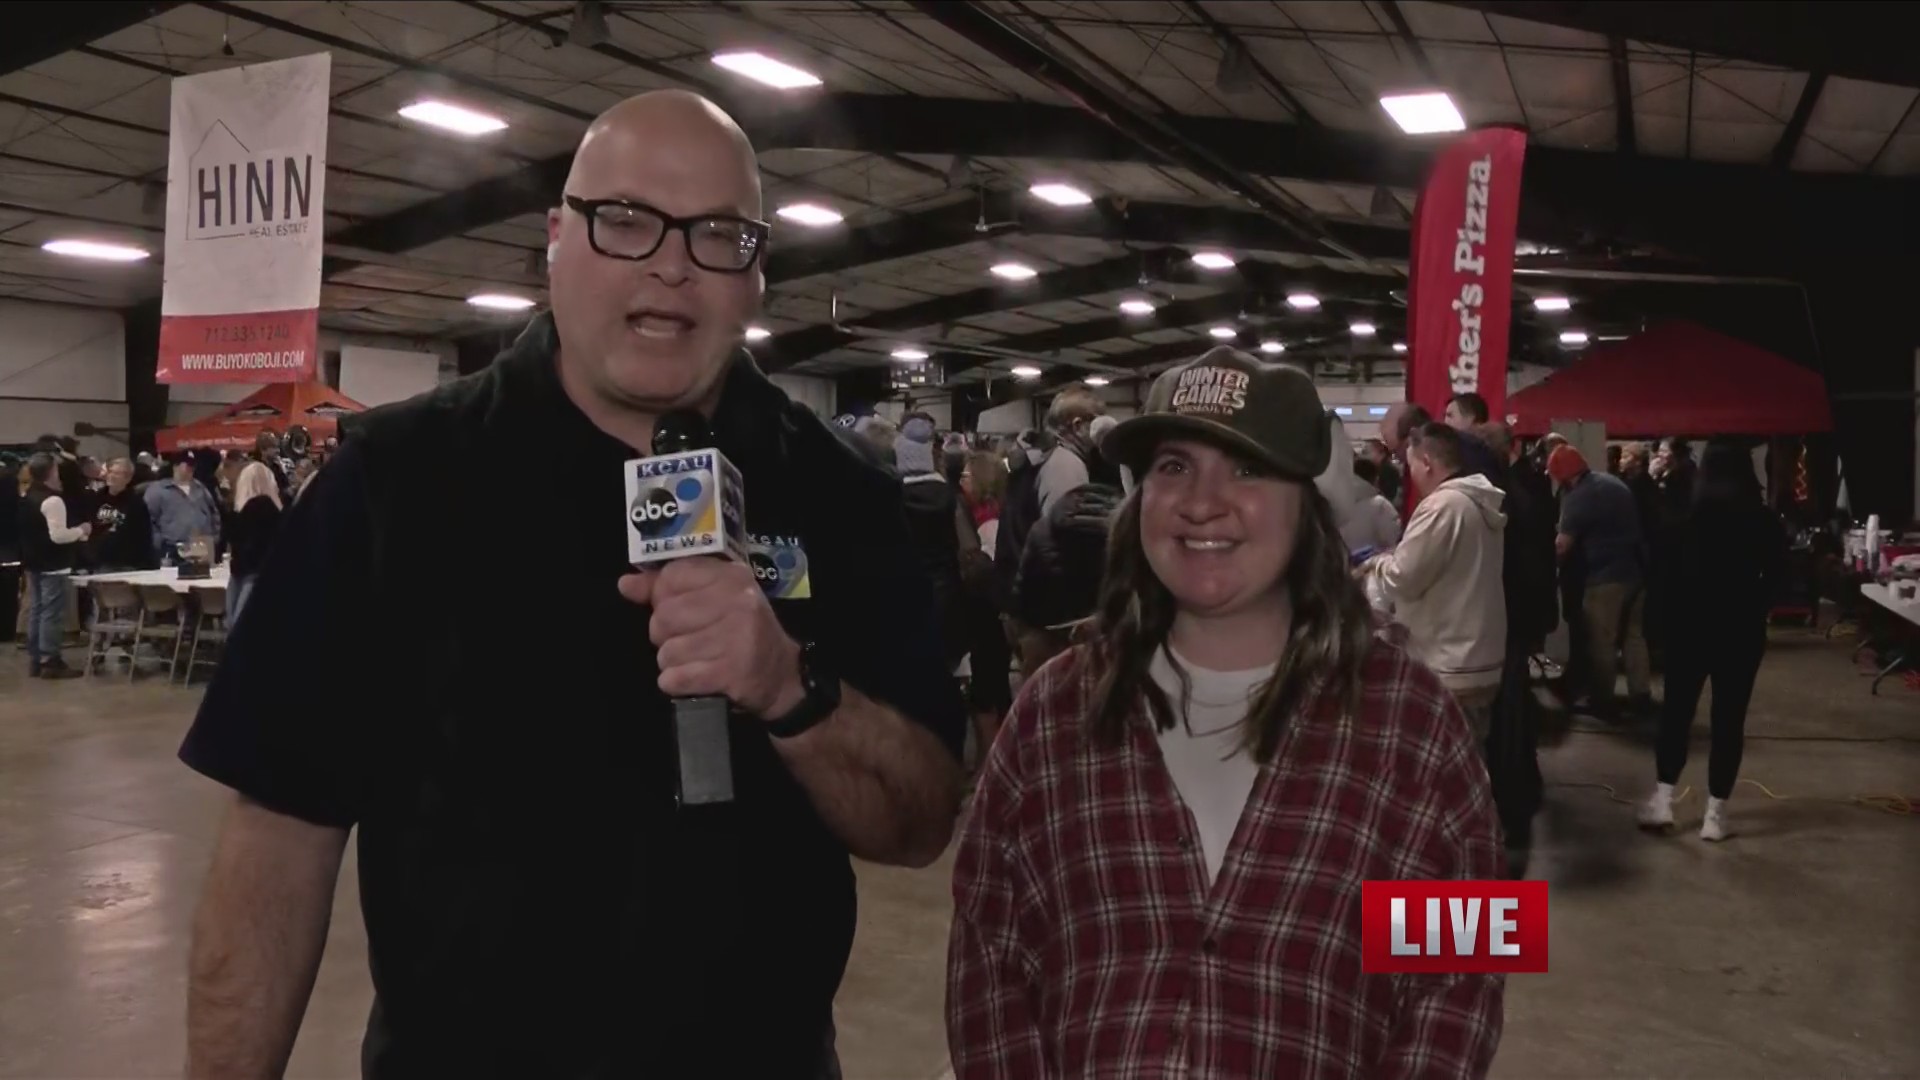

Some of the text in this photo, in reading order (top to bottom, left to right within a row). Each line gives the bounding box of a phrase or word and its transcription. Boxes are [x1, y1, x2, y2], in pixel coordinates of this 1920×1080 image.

[198, 154, 312, 228] HINN
[1454, 154, 1491, 276] Pizza
[249, 222, 309, 238] REAL ESTATE
[182, 350, 305, 369] WWW.BUYOKOBOJI.COM
[1180, 366, 1249, 389] WINTER
[1172, 383, 1247, 409] GAMES
[642, 456, 708, 475] KCAU
[631, 499, 679, 522] abc
[646, 533, 712, 553] NEWS
[752, 561, 778, 580] bc
